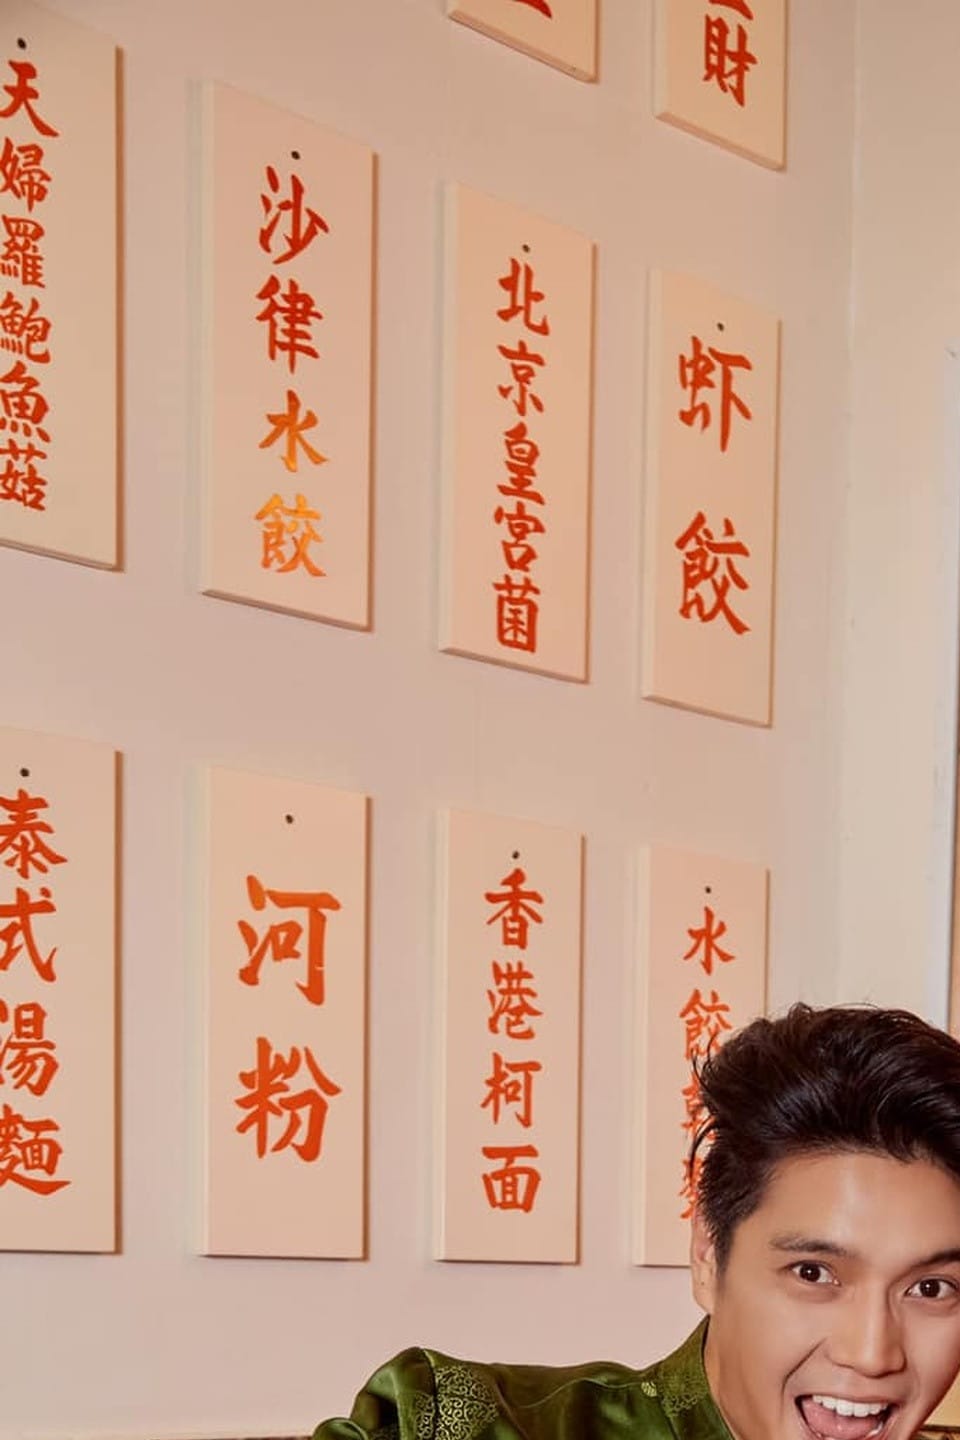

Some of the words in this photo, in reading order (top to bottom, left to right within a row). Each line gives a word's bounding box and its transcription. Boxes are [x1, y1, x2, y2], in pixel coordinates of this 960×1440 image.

[702, 0, 757, 107] 財
[255, 164, 331, 579] 沙律水餃
[492, 256, 551, 655] 北京皇宮菌
[674, 335, 753, 636] 虾餃
[235, 874, 343, 1163] 河粉
[480, 867, 545, 1214] 香港柯面
